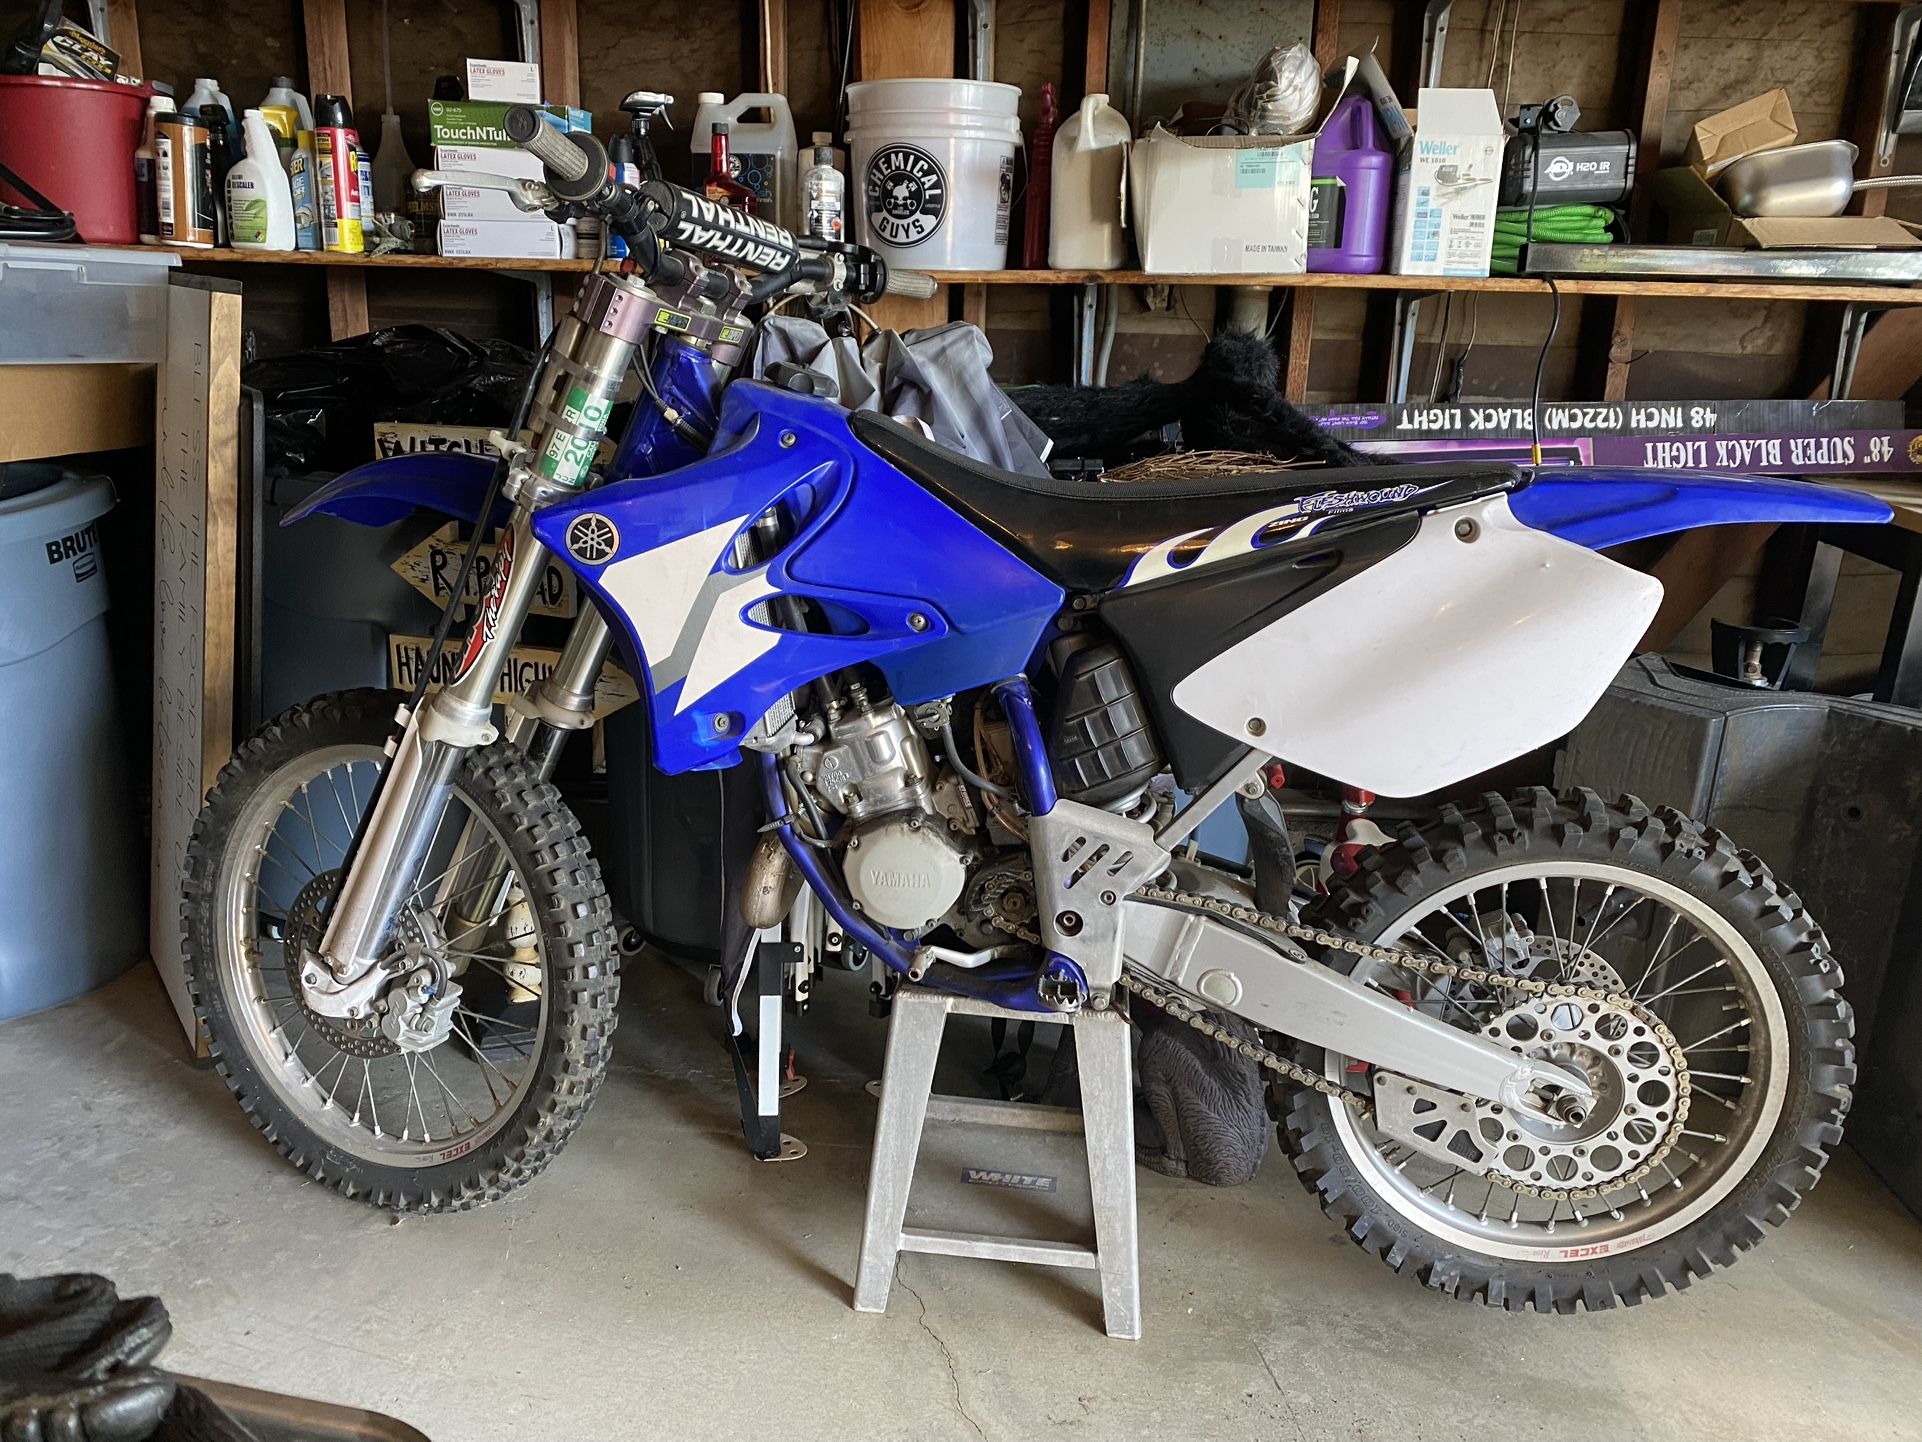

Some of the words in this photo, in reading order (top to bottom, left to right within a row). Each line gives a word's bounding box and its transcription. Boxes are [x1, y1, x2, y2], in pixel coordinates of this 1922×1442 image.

[52, 35, 113, 65] CLAY
[470, 67, 486, 75] LATEX
[486, 68, 505, 76] GLOVES
[1420, 141, 1458, 156] Weller
[868, 152, 942, 199] CHEMICAL
[1600, 161, 1611, 171] IR
[680, 190, 793, 249] RENTHAL
[878, 216, 925, 240] GUYS
[678, 220, 791, 272] RENTHAL
[1245, 245, 1260, 253] MADE
[1268, 245, 1288, 253] TAIWAN
[192, 342, 202, 482] BLESS
[1397, 408, 1462, 430] LIGHT
[1470, 407, 1536, 430] BLACK
[1544, 405, 1624, 429] (122CM)
[1631, 406, 1682, 428] INCH
[1692, 407, 1717, 428] 48
[1644, 441, 1707, 468] LIGHT
[1714, 439, 1781, 466] BLACK
[1789, 437, 1855, 465] SUPER
[1863, 436, 1894, 463] 48"
[179, 432, 189, 496] THE
[190, 513, 200, 586] THE
[177, 522, 187, 668] FAMILY
[188, 604, 199, 739] FOOD
[870, 869, 931, 889] YAMAHA
[440, 1141, 471, 1160] EXCEL
[968, 1169, 1053, 1187] WHITE
[1559, 1243, 1610, 1258] EXCEL
